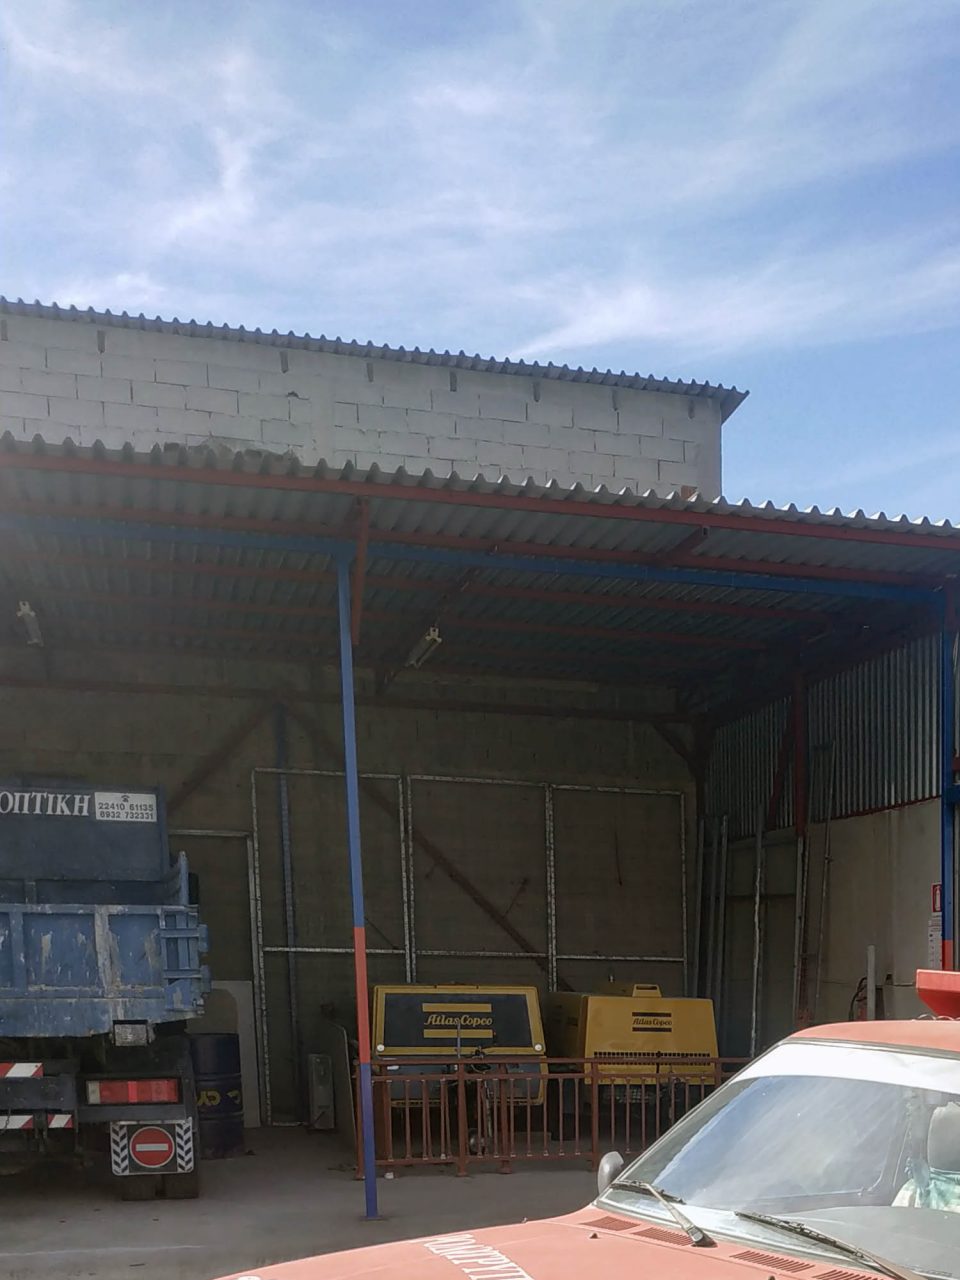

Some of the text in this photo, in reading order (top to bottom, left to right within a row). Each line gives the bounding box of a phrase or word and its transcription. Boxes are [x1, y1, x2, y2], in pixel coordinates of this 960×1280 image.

[0, 791, 91, 816] ΟΠΤΙΚΗ
[98, 802, 126, 811] 22410
[125, 811, 154, 820] 732331
[460, 1014, 493, 1028] Copco
